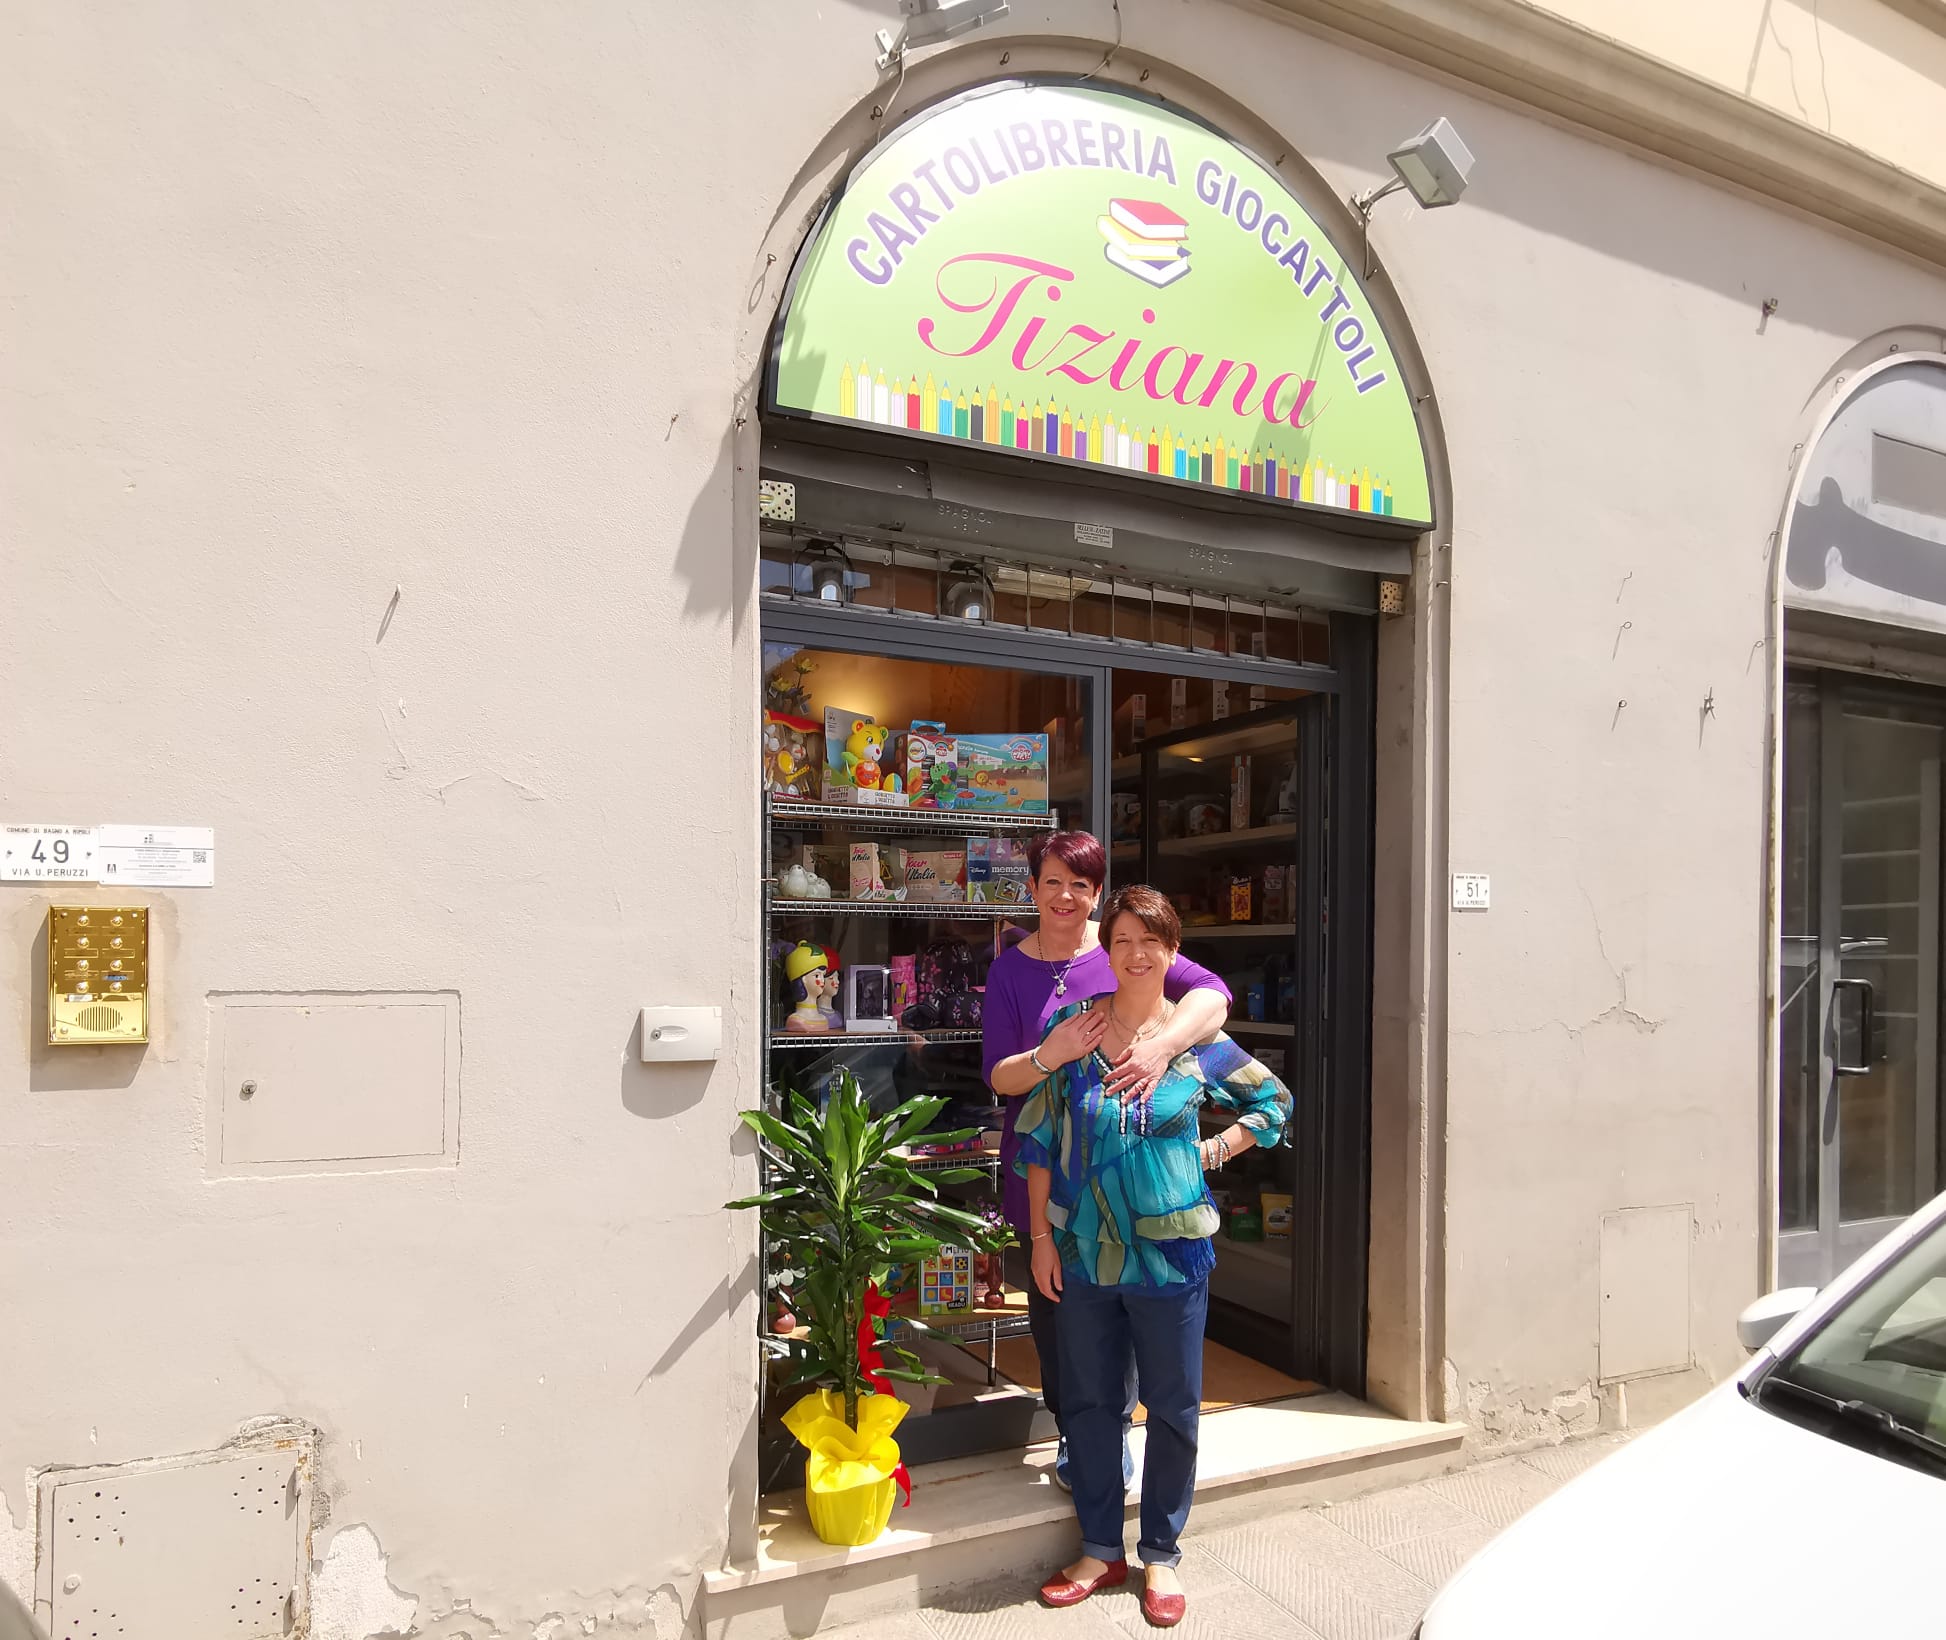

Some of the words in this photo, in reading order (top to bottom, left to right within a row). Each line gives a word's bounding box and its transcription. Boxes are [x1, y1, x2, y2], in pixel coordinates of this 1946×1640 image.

[846, 118, 1178, 285] CARTOLIBRERIA
[1194, 160, 1388, 394] GIOCATTOLI
[917, 252, 1332, 429] Tiziana
[31, 839, 69, 864] 49
[12, 868, 31, 876] VIA
[991, 866, 1029, 875] memory
[1466, 882, 1479, 898] 51
